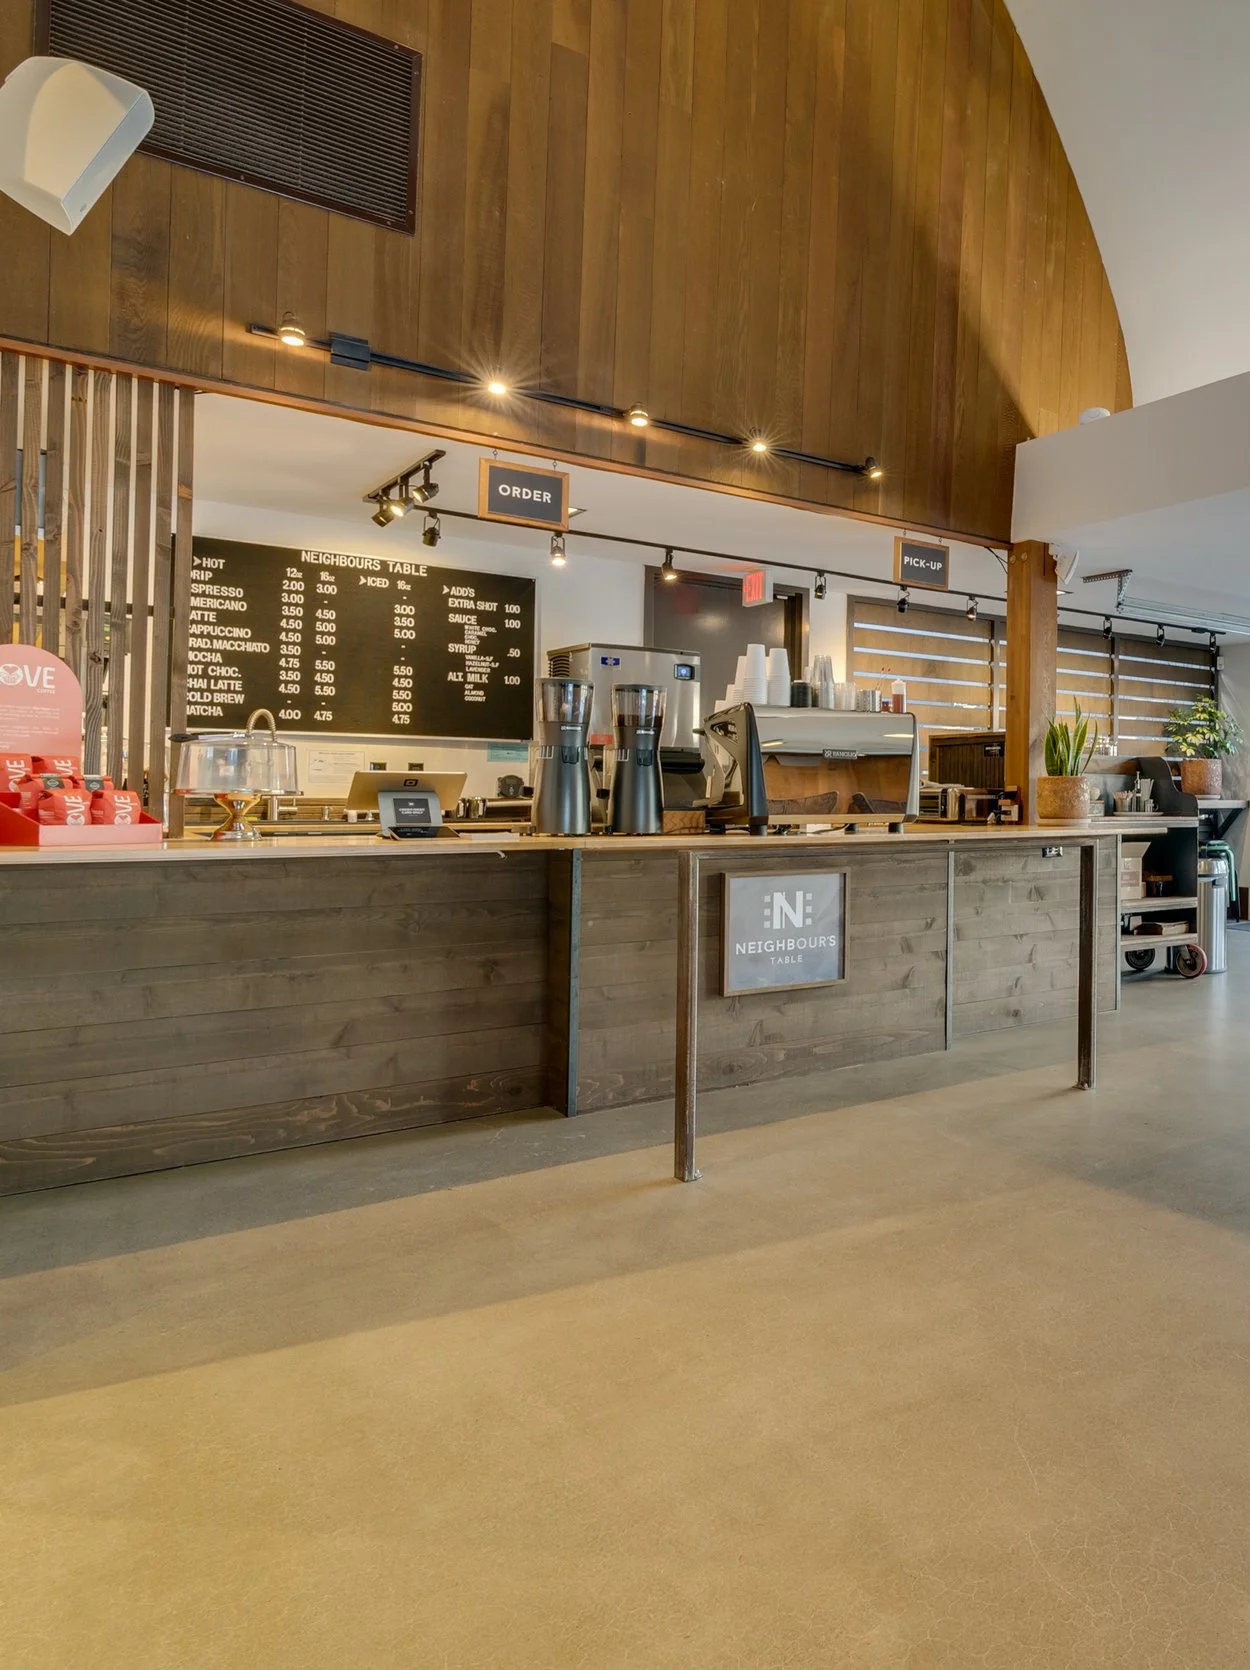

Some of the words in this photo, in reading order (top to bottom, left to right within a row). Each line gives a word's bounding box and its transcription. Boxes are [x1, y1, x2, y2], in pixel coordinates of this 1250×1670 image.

[498, 484, 552, 503] ORDER
[202, 557, 225, 569] HOT
[286, 568, 302, 578] 12oz
[367, 576, 389, 588] ICED
[301, 550, 381, 570] NEIGHBOURS
[387, 561, 428, 577] TABLE
[904, 556, 942, 570] PICK-UP
[190, 570, 212, 580] RIP
[282, 580, 304, 591] 2.00
[316, 584, 337, 594] 3.00
[744, 570, 764, 602] EXIT
[191, 583, 243, 598] SPRESSO
[282, 593, 304, 604] 3.00
[394, 604, 415, 615] 3.00
[450, 586, 475, 598] ADD'S
[190, 596, 247, 611] MERICANO
[282, 606, 303, 616] 3.50
[316, 608, 336, 620] 4.50
[394, 616, 414, 627] 3.50
[448, 598, 475, 610] EXTRA
[476, 601, 498, 612] SHOT
[190, 610, 216, 622] ATTE
[280, 619, 302, 630] 4.50
[316, 622, 336, 632] 5.00
[394, 628, 416, 639] 5.00
[448, 614, 477, 624] SAUCE
[189, 624, 251, 638] APPUCCINO
[280, 632, 301, 642] 4.50
[316, 634, 336, 645] 5.00
[189, 638, 212, 648] RAD.
[213, 640, 270, 653] MACCHIATO
[280, 644, 300, 656] 3.50
[448, 643, 476, 654] SYRUP
[0, 664, 56, 688] OVE
[280, 658, 300, 668] 4.75
[315, 660, 335, 670] 5.50
[394, 666, 412, 676] 5.50
[208, 666, 242, 677] CHOC.
[280, 670, 300, 681] 3.50
[314, 673, 334, 683] 4.50
[392, 678, 412, 688] 4.50
[466, 673, 488, 683] MILK
[186, 678, 207, 689] HAI
[210, 679, 242, 690] LATTE
[279, 684, 300, 694] 4.50
[315, 686, 336, 696] 5.50
[392, 690, 412, 700] 5.50
[186, 692, 211, 702] OLD
[214, 693, 244, 704] BREW
[392, 702, 412, 712] 5.00
[279, 709, 301, 720] 4.00
[314, 711, 332, 721] 4.75
[392, 714, 410, 724] 4.75
[736, 936, 836, 954] NEIGHBOUR'S
[770, 955, 802, 965] TABLE
